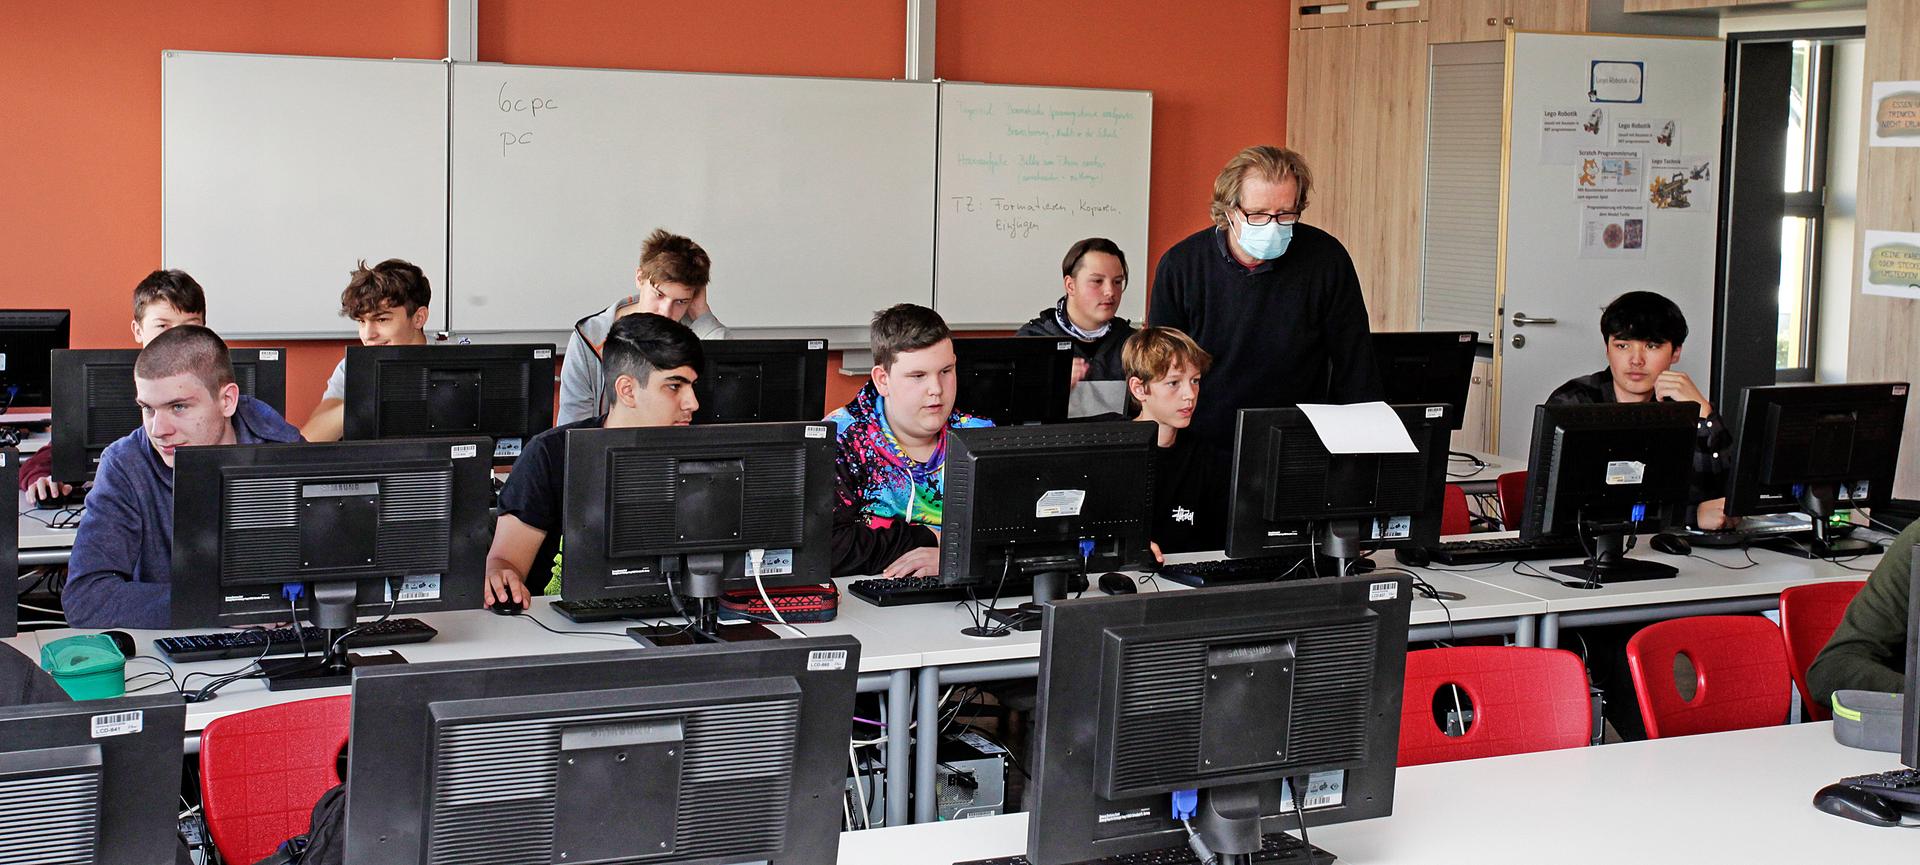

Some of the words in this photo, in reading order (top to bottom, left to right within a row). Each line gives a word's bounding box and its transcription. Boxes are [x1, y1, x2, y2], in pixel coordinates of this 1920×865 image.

[1544, 110, 1557, 118] Lego
[1618, 122, 1630, 130] Lego
[1597, 150, 1638, 158] Programmierung
